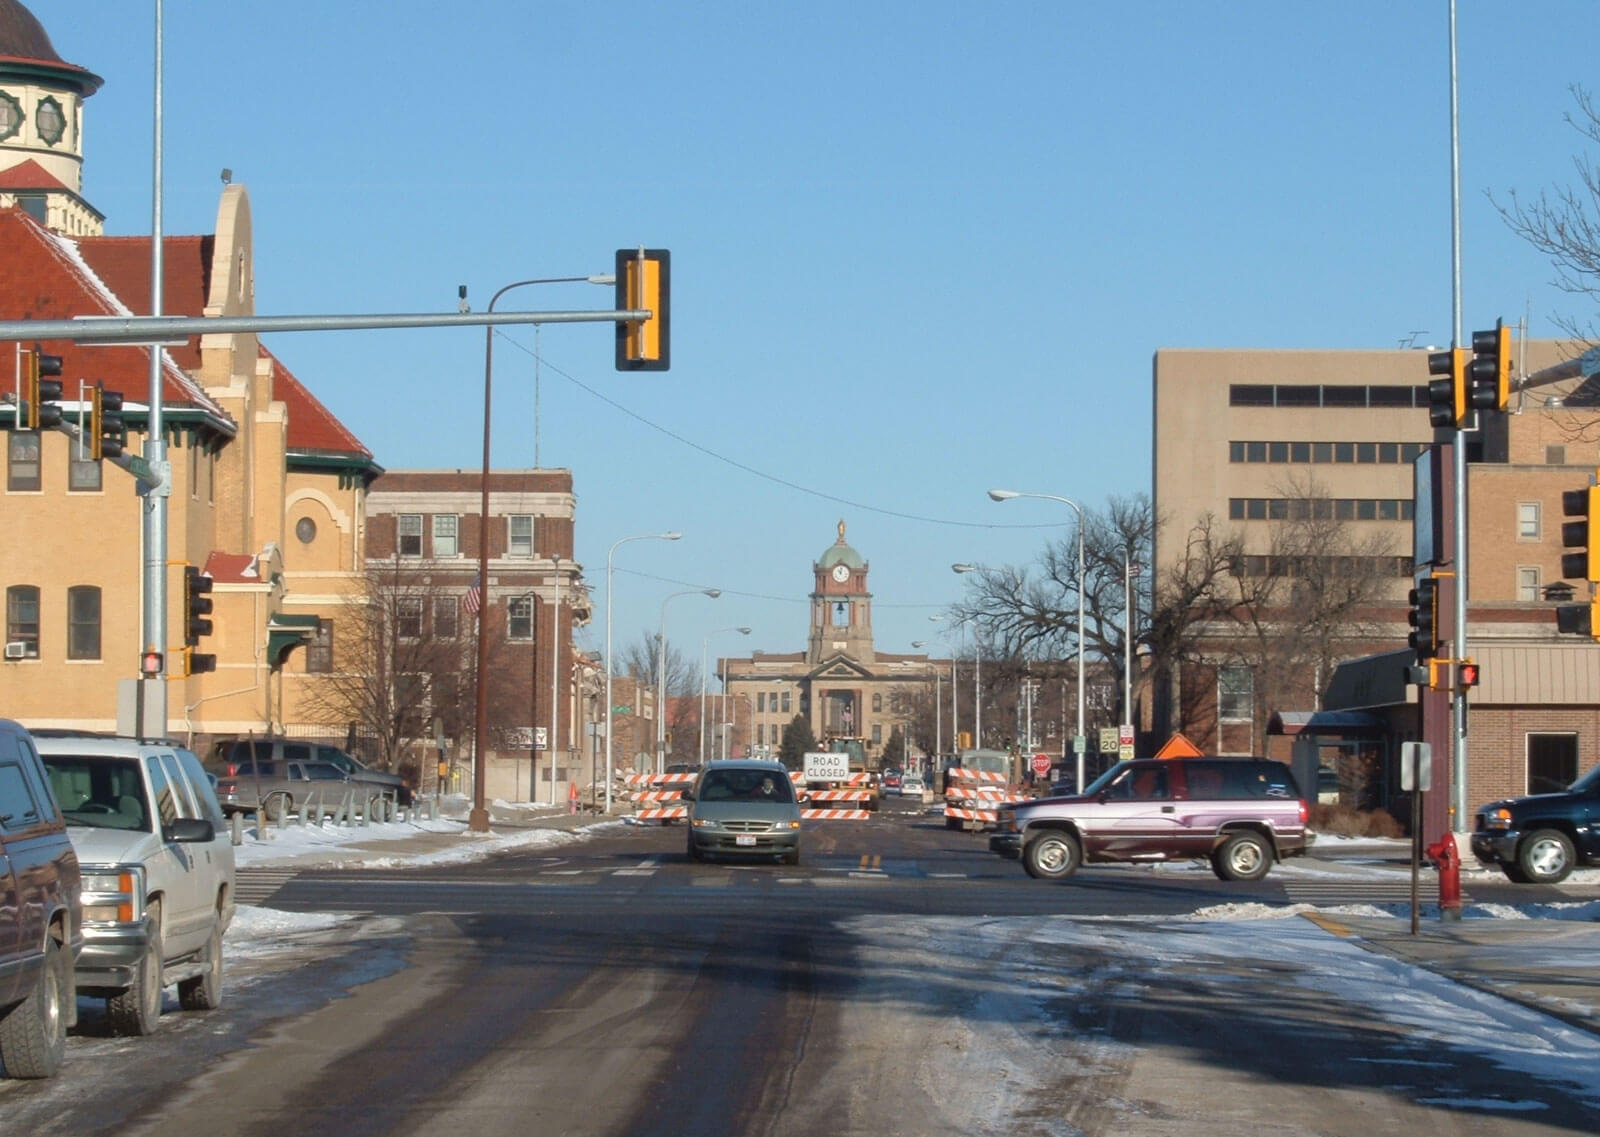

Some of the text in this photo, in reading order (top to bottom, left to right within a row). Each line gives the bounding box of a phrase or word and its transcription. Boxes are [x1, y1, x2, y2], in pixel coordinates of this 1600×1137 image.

[1102, 740, 1117, 750] 20
[813, 756, 840, 766] ROAD
[1032, 759, 1050, 767] STOP
[807, 768, 846, 777] CLOSED
